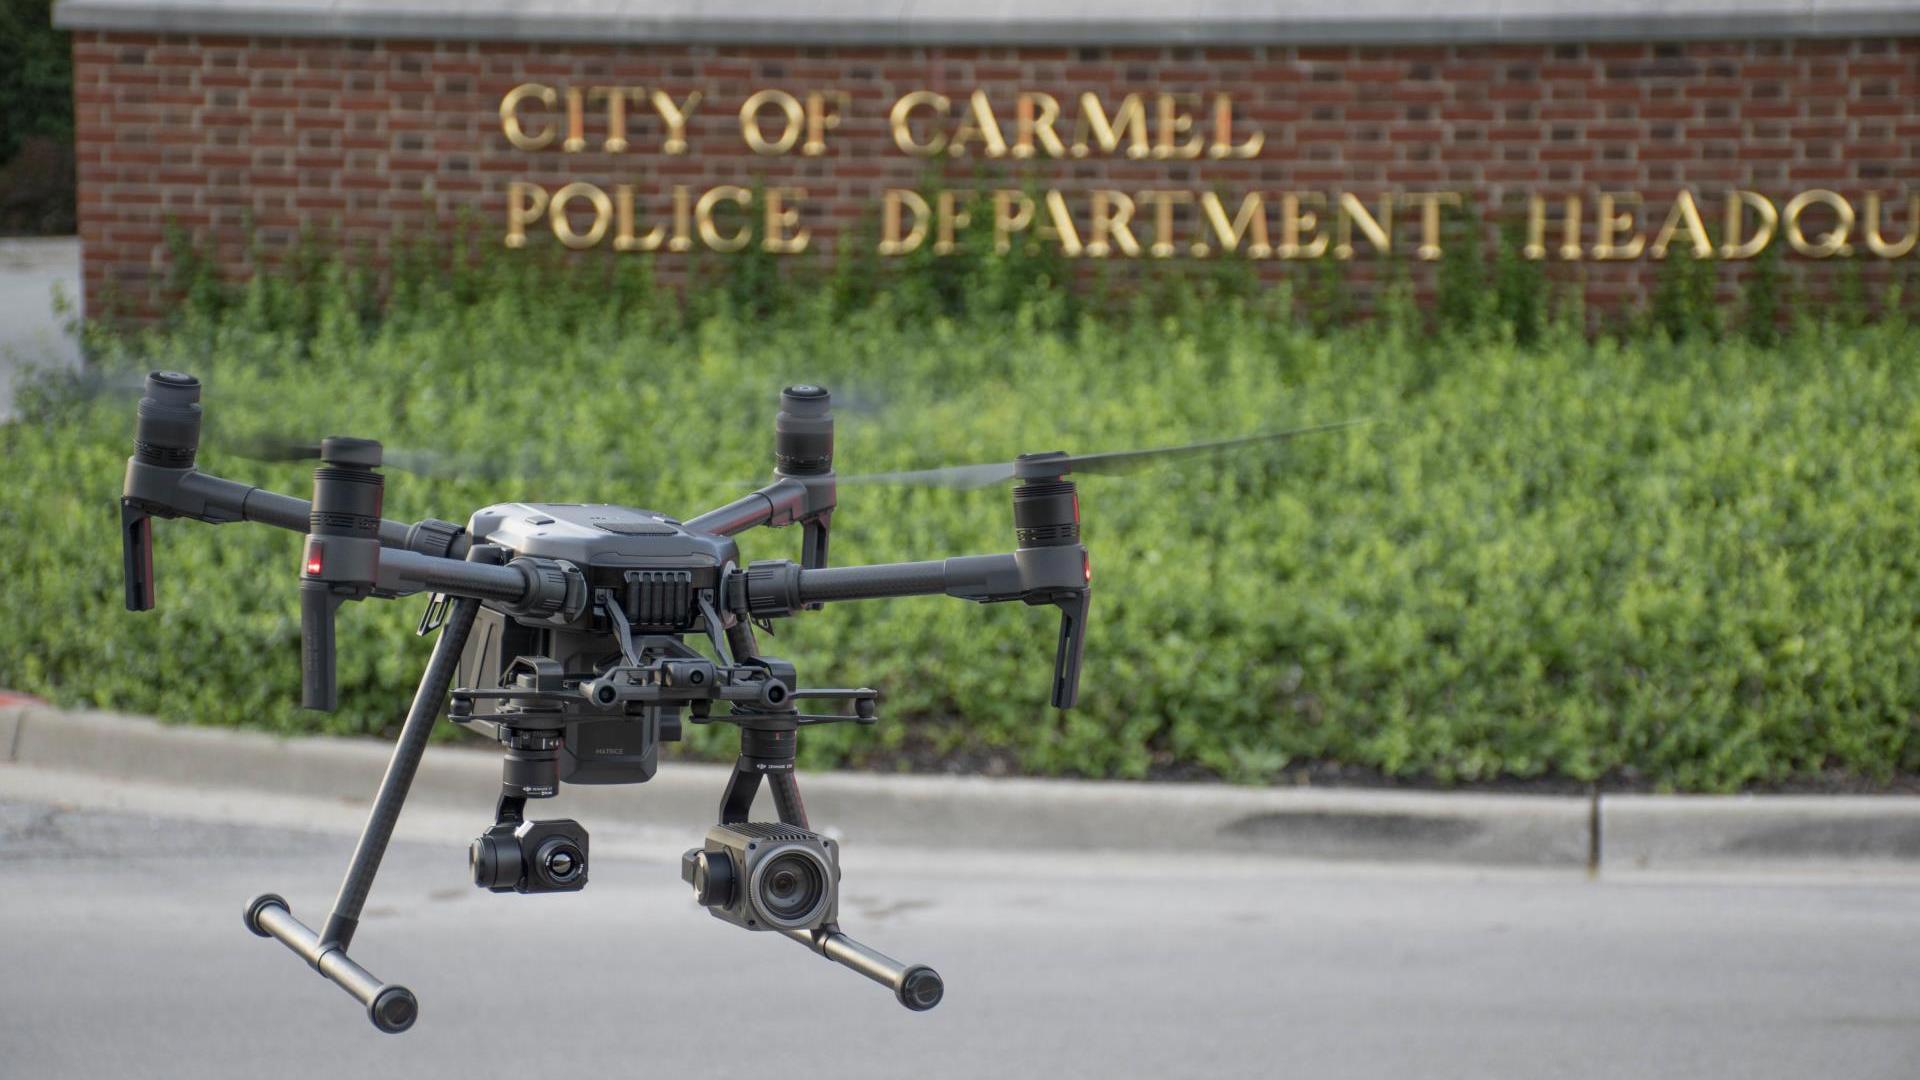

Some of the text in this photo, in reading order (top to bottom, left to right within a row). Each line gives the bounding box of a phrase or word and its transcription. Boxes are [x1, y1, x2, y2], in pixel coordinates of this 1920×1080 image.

[499, 83, 1265, 159] CITY OF CARMEL
[504, 181, 1920, 260] POLICE DEPARTMENT HEADQU
